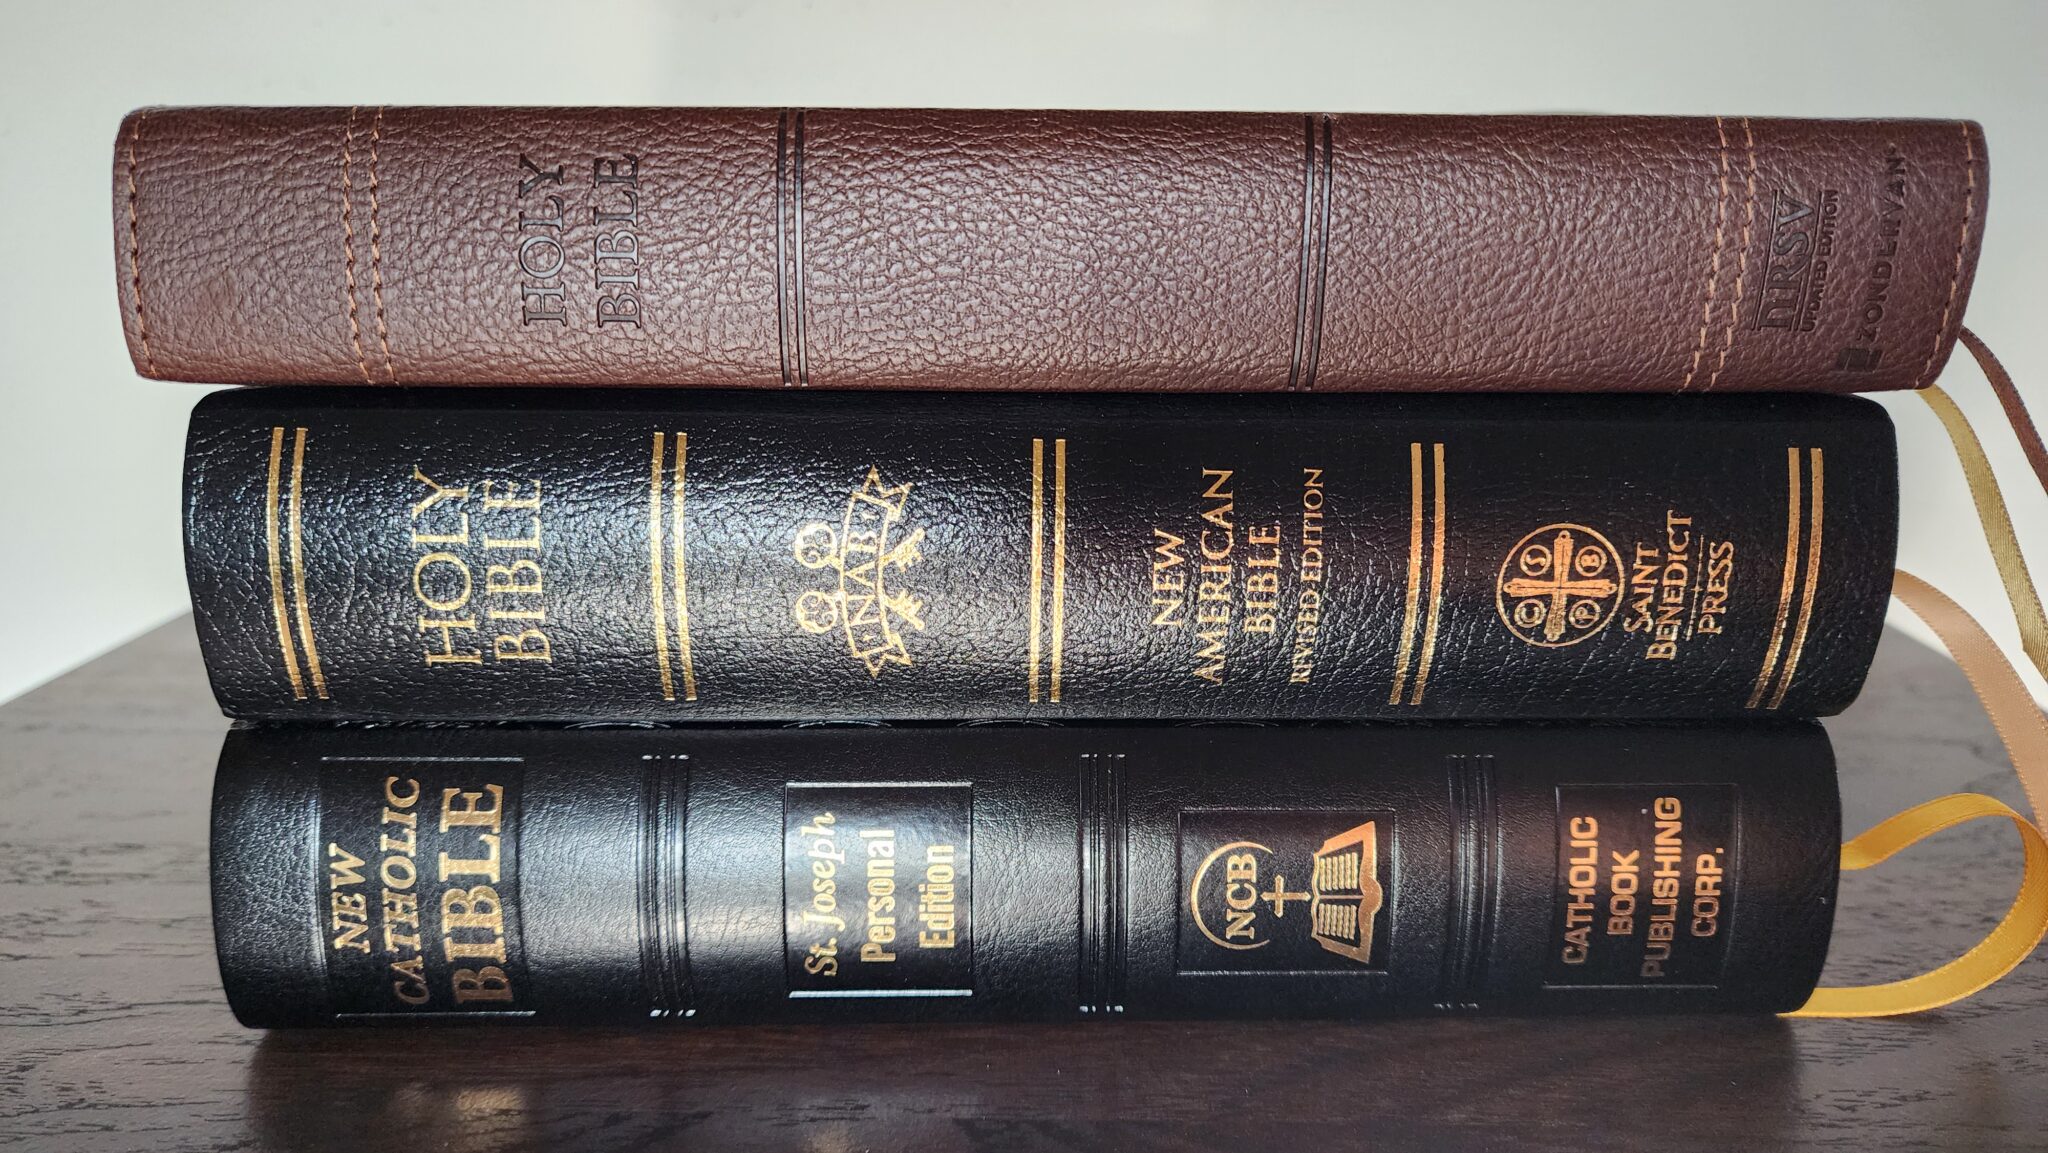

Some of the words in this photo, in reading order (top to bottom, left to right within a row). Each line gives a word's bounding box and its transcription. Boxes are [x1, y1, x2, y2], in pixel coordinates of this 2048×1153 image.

[519, 153, 567, 326] HOLY
[594, 154, 641, 328] BIBLE
[413, 464, 483, 668] HOLY
[484, 478, 552, 664] BIBLE
[1150, 528, 1185, 628] NEW
[1193, 467, 1234, 685] AMERICAN
[1244, 523, 1281, 633] BIBLE
[1301, 468, 1324, 583] EDITION
[1290, 589, 1320, 684] REVISED
[1623, 541, 1660, 634] SAINT
[1645, 509, 1692, 661] BENEDICT
[1698, 540, 1734, 635] PRESS
[328, 842, 371, 954] NEW
[379, 775, 430, 1005] CATHOLIC
[438, 783, 514, 1004] BIBLE
[800, 811, 847, 933] Joseph
[859, 829, 897, 963] Personal
[918, 845, 955, 949] Edition
[1225, 853, 1258, 940] NCB
[1561, 816, 1599, 965] CATHOLIC
[1606, 849, 1641, 935] BOOK
[1639, 796, 1683, 977] PUBLISHING
[1690, 847, 1725, 937] CORP.
[804, 937, 839, 977] St.
